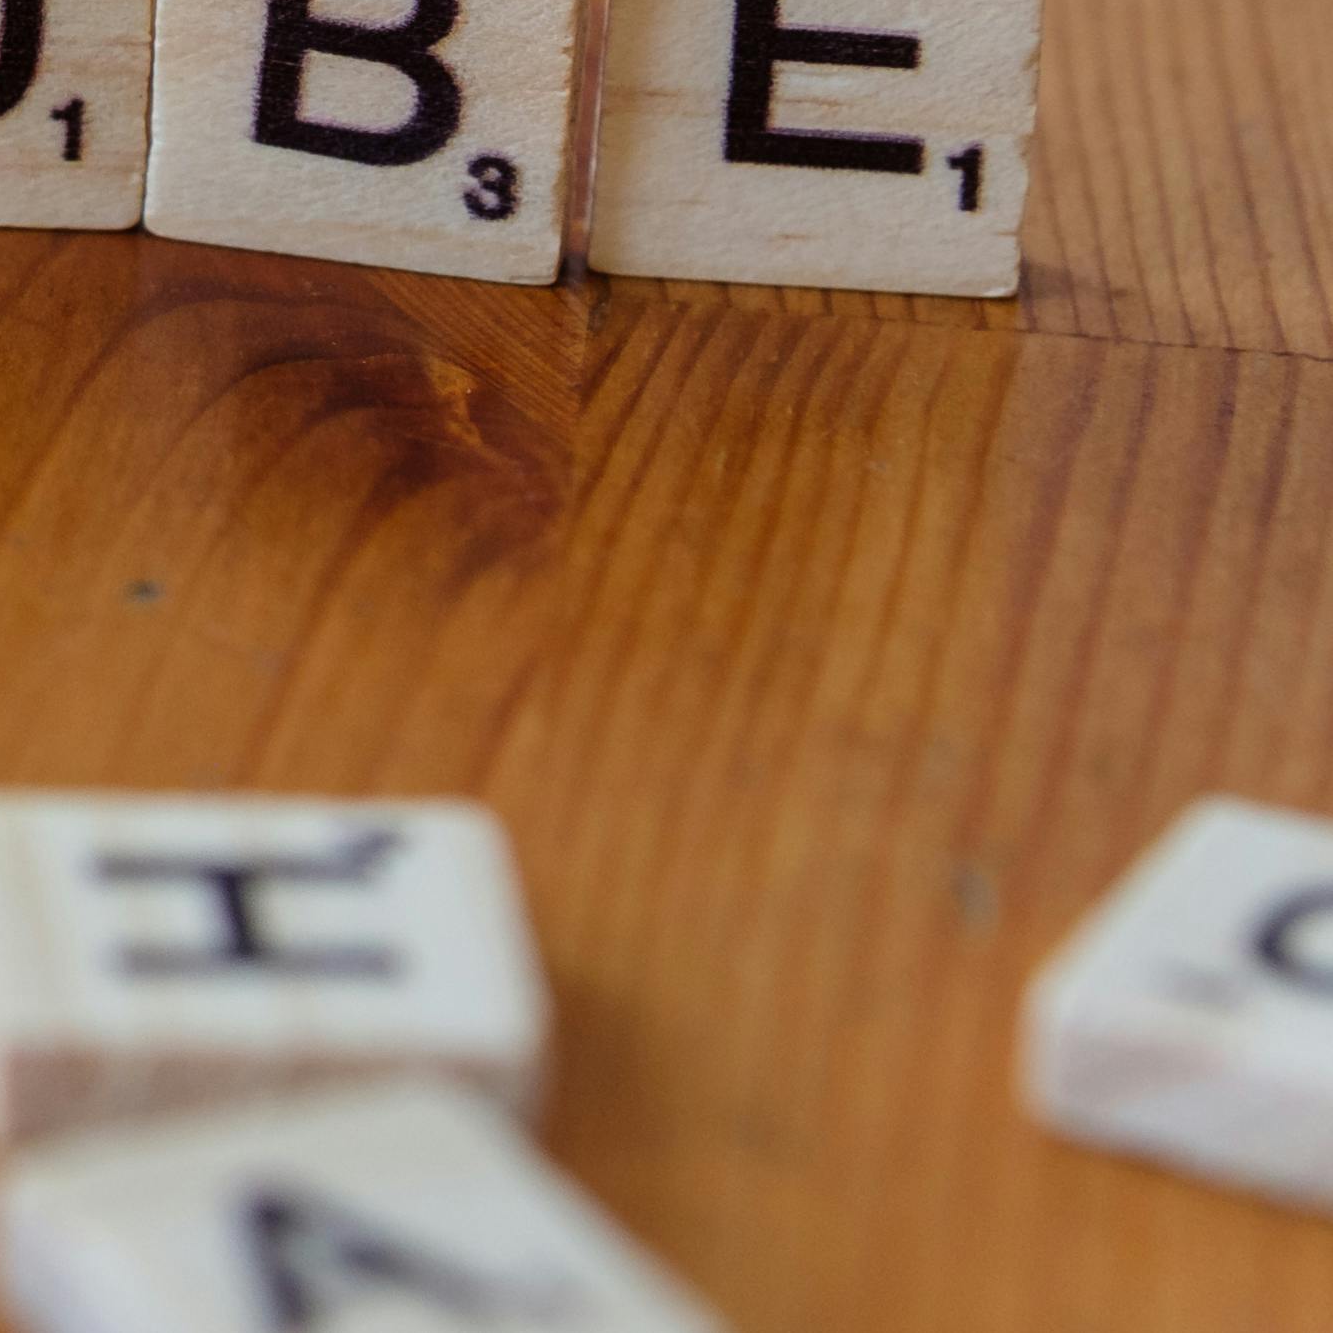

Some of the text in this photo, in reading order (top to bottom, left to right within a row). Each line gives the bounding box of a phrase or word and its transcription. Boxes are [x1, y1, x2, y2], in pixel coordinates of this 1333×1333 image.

[48, 95, 89, 164] 1
[461, 153, 521, 222] 3
[945, 143, 985, 213] 1
[89, 849, 409, 982] H
